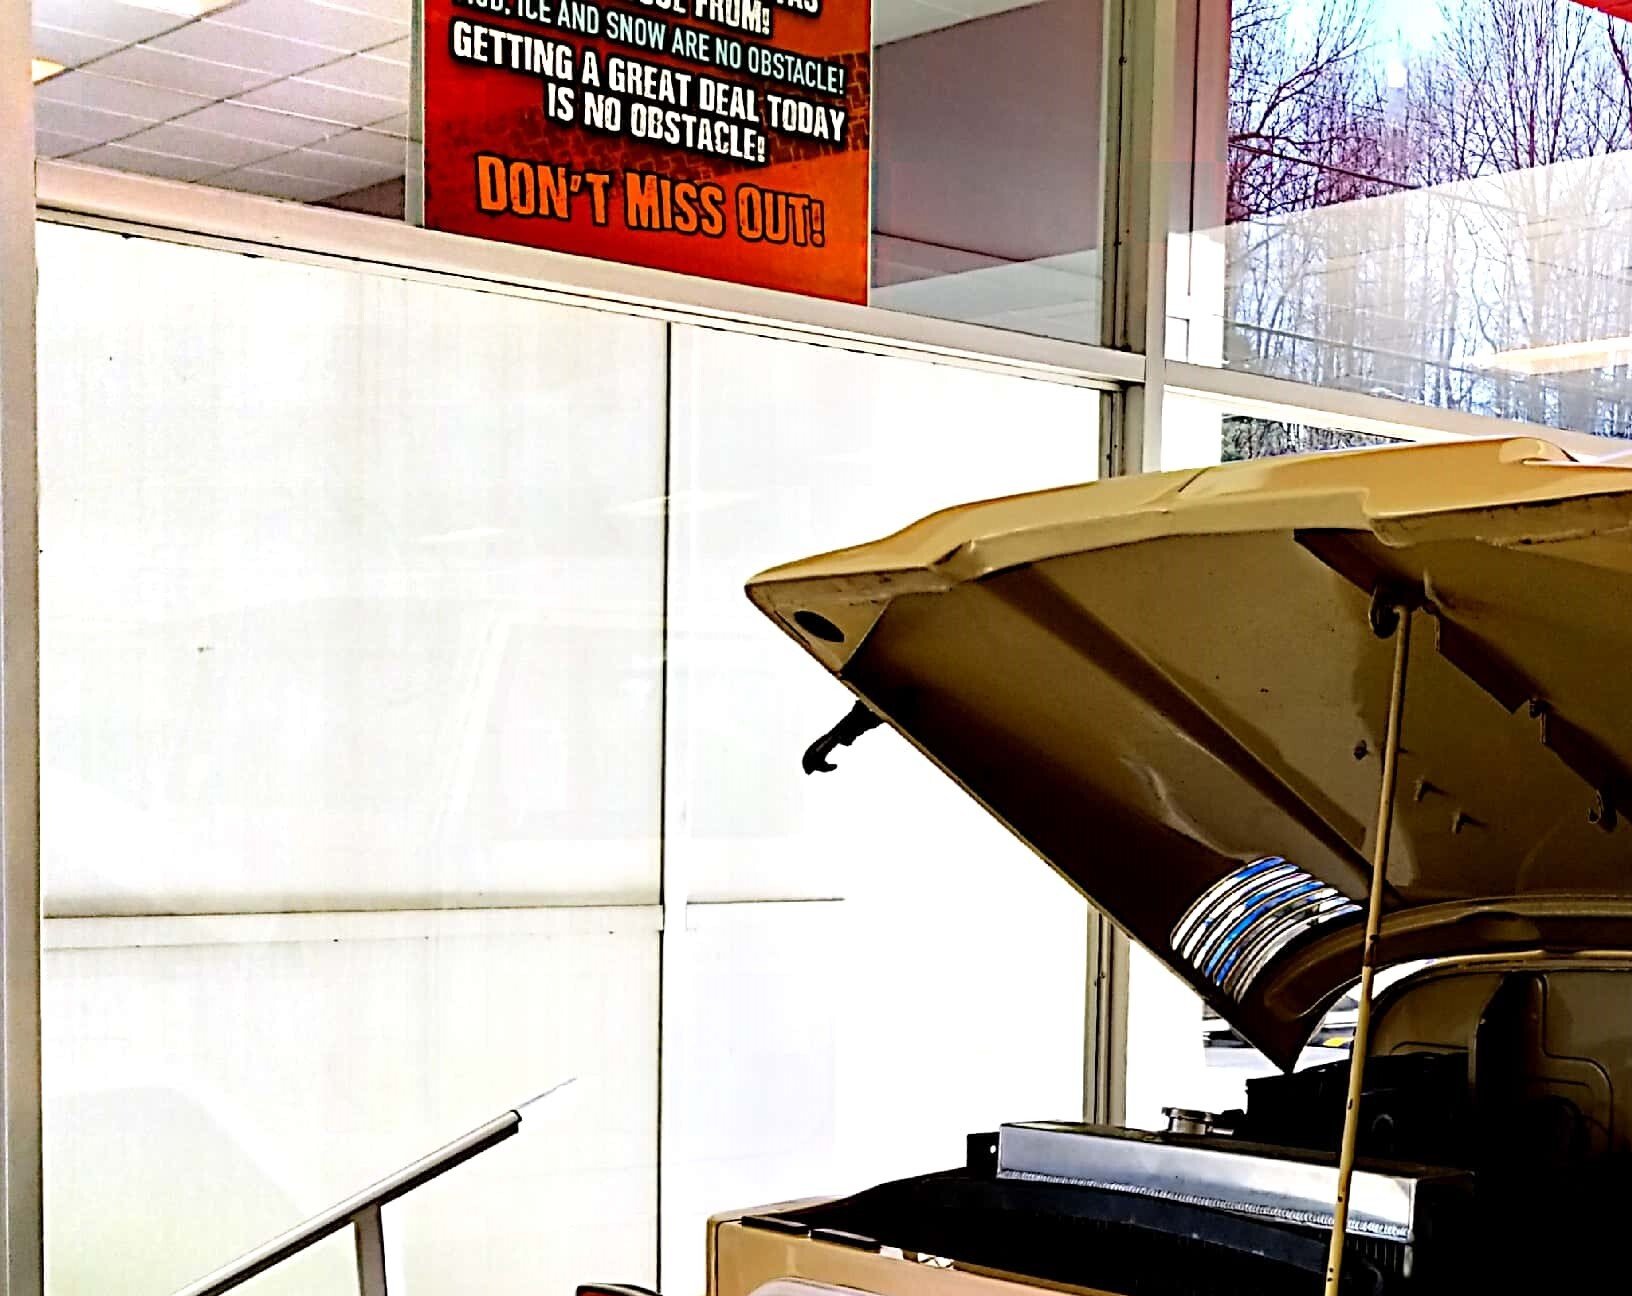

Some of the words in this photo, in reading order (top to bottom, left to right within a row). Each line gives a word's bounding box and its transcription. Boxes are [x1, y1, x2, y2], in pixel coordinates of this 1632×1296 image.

[453, 20, 573, 81] GETTING
[582, 51, 600, 87] A
[608, 57, 692, 107] GREAT
[700, 78, 760, 122] DEAL
[767, 94, 845, 142] TODAY
[557, 1, 599, 34] AND
[606, 11, 666, 50] SNOW
[671, 27, 710, 62] ARE
[715, 37, 741, 69] NO
[749, 46, 844, 95] OBSTACLE!
[548, 83, 575, 121] IS
[584, 92, 621, 131] NO
[630, 102, 766, 163] OBSTACLE!
[478, 155, 609, 224] DON'T
[624, 172, 723, 236] MISS
[739, 186, 824, 245] OUT!
